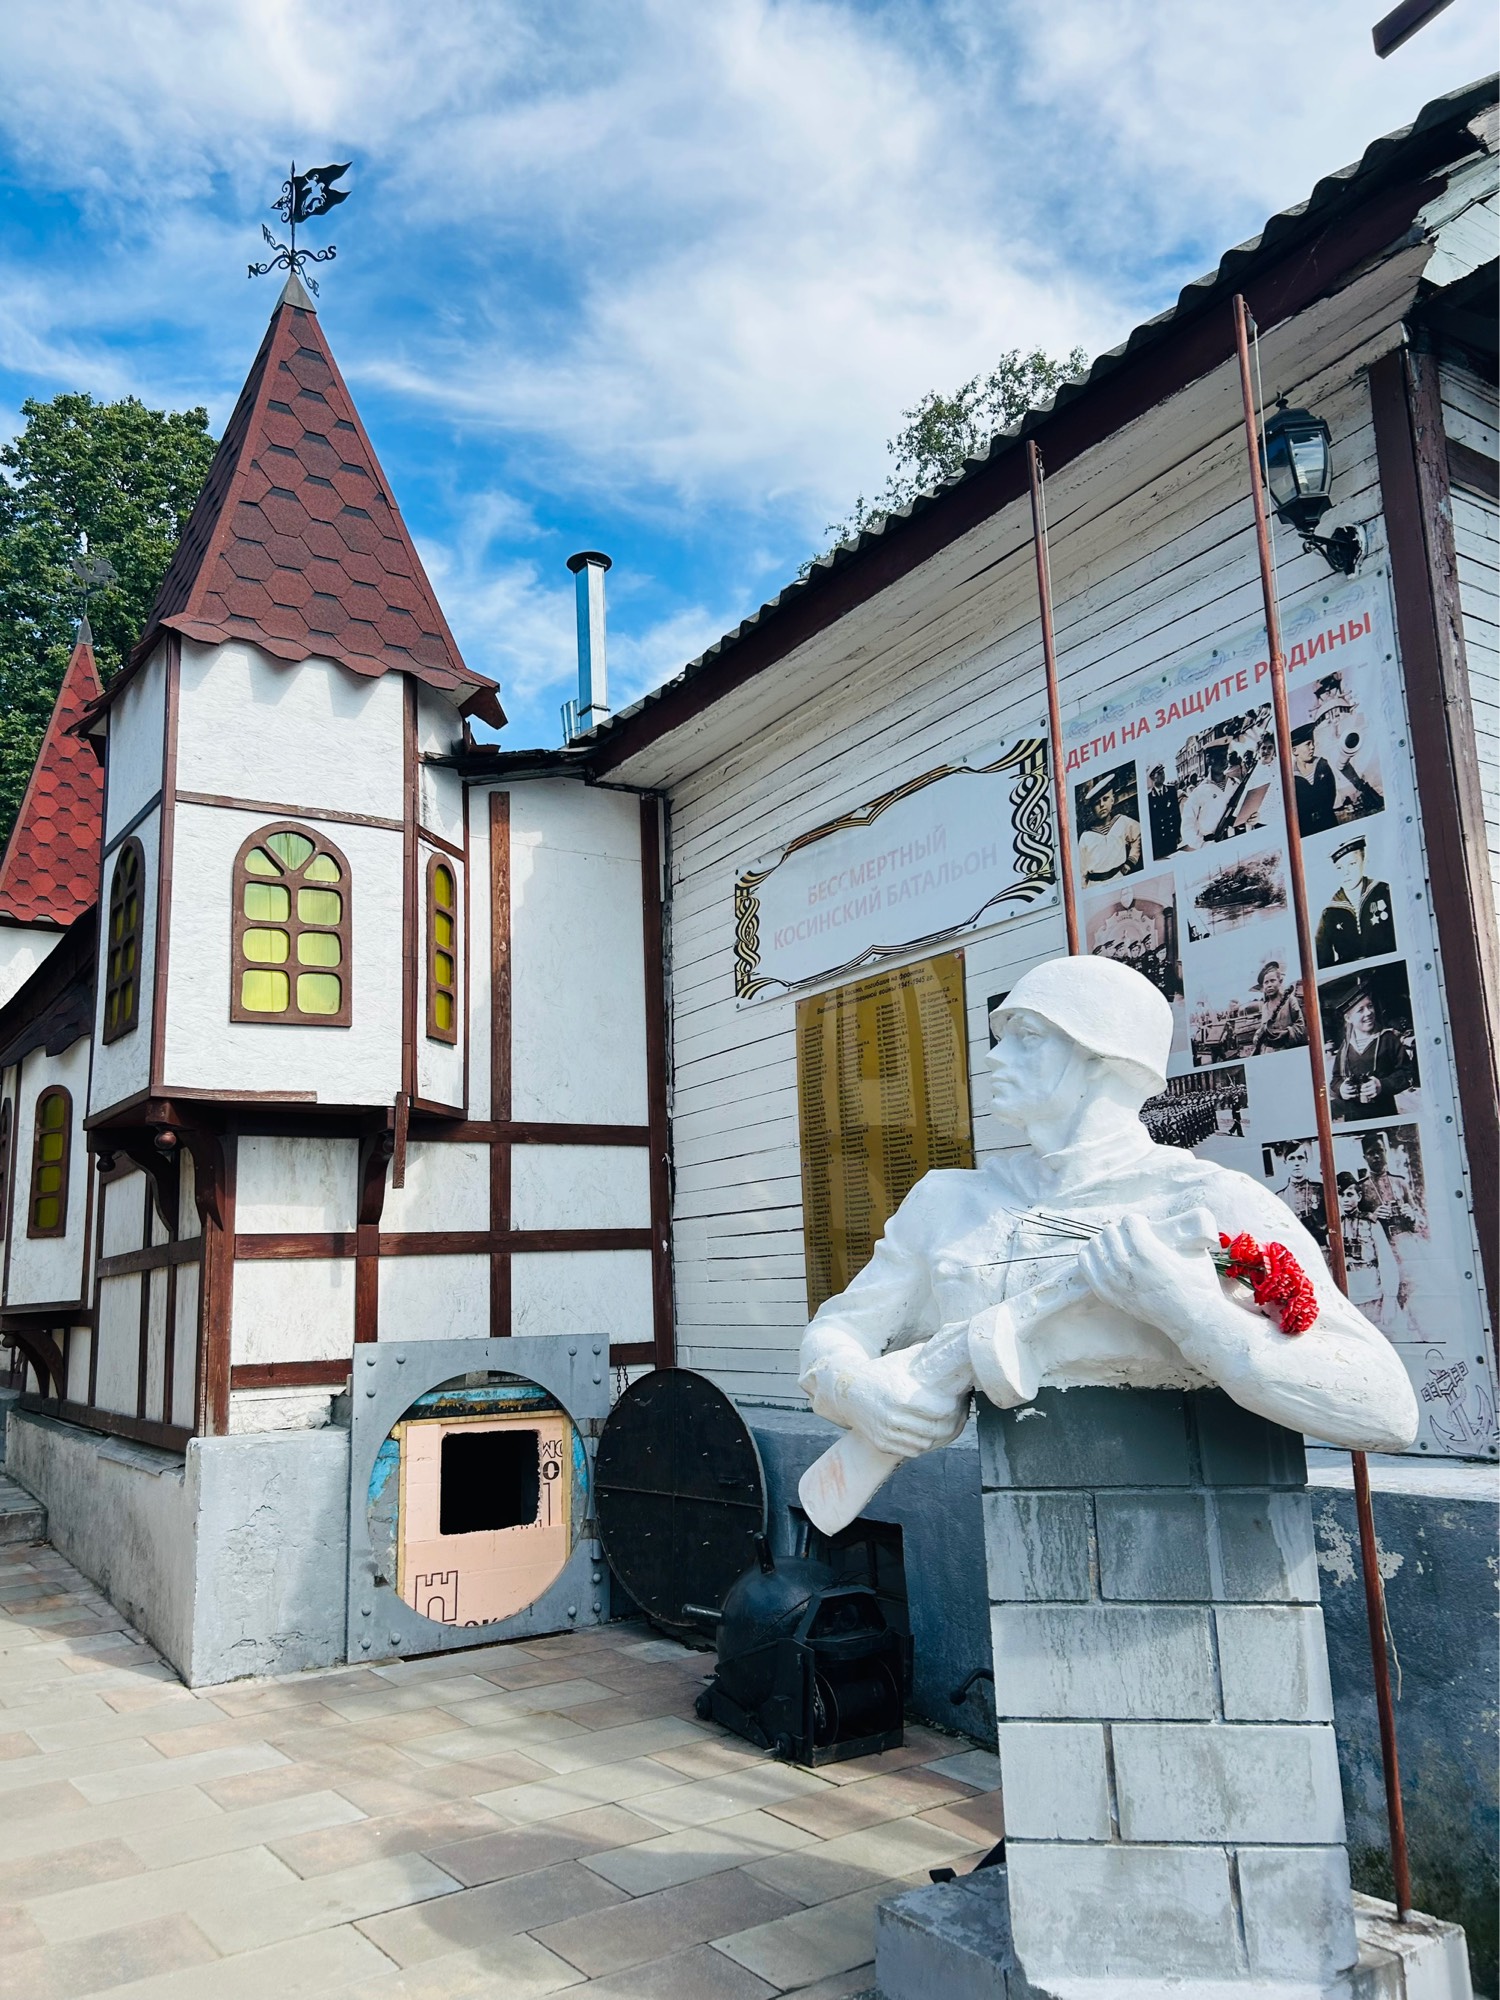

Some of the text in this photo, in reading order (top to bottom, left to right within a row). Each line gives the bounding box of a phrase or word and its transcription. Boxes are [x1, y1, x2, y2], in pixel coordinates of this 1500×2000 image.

[247, 263, 259, 279] N
[1065, 612, 1372, 773] ДЕТИ НА ЗАЩИТЕ РДИНЫ
[773, 843, 998, 951] КОСИНСКИЙ БАТАЛЬОН
[807, 823, 948, 907] БЕССМЕРТНЫЙ
